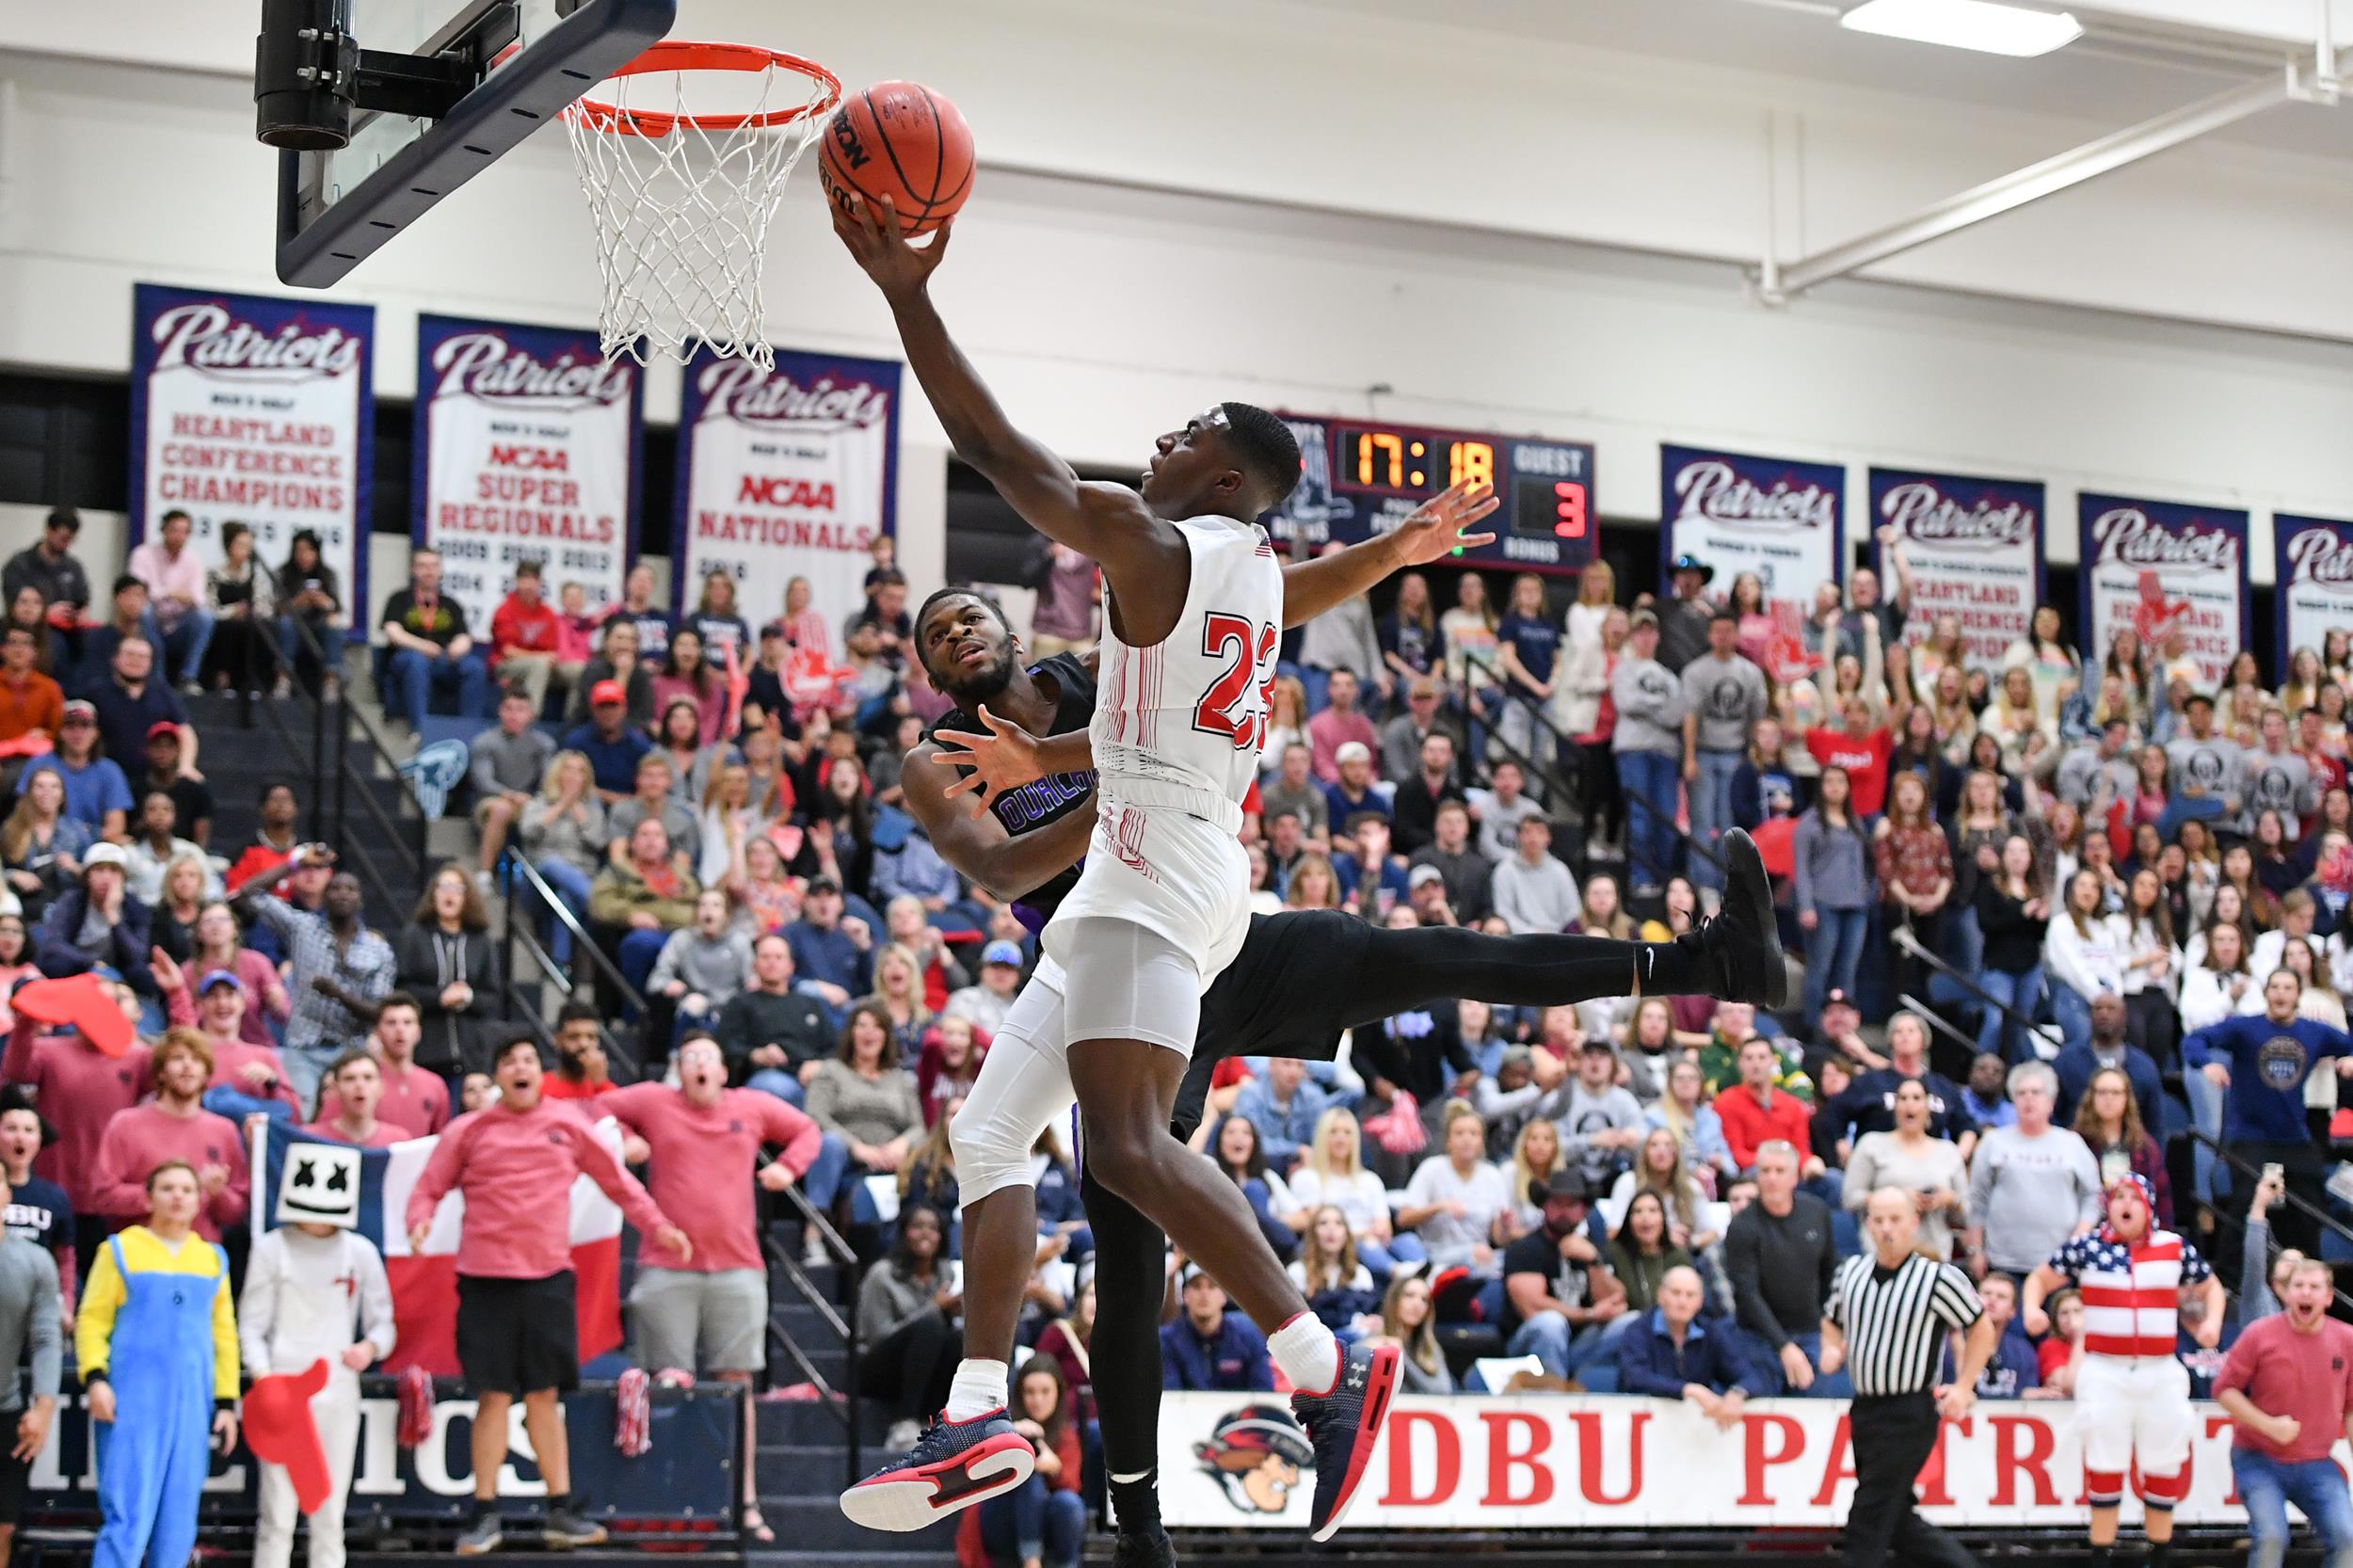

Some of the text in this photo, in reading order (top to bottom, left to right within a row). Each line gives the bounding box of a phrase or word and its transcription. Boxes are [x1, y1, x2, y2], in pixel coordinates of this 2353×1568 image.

[152, 304, 361, 375] Patriots
[432, 333, 632, 400] Patriots
[697, 358, 888, 426] Patriots
[172, 412, 334, 446] HEARTLAND
[161, 442, 342, 478] CONFERENCE
[488, 443, 568, 472] NCAA
[1513, 444, 1583, 476] GUEST
[159, 473, 343, 511] CHAMPIONS
[477, 472, 580, 506] SUPER
[738, 473, 836, 511] NCAA
[1554, 482, 1587, 537] 3
[1674, 461, 1834, 527] Patriots
[440, 503, 615, 544] REGIONALS
[697, 510, 872, 552] NATIONALS
[1881, 483, 2035, 543] Patriots
[2093, 507, 2238, 568] Patriots
[1378, 1411, 1653, 1507] DBU
